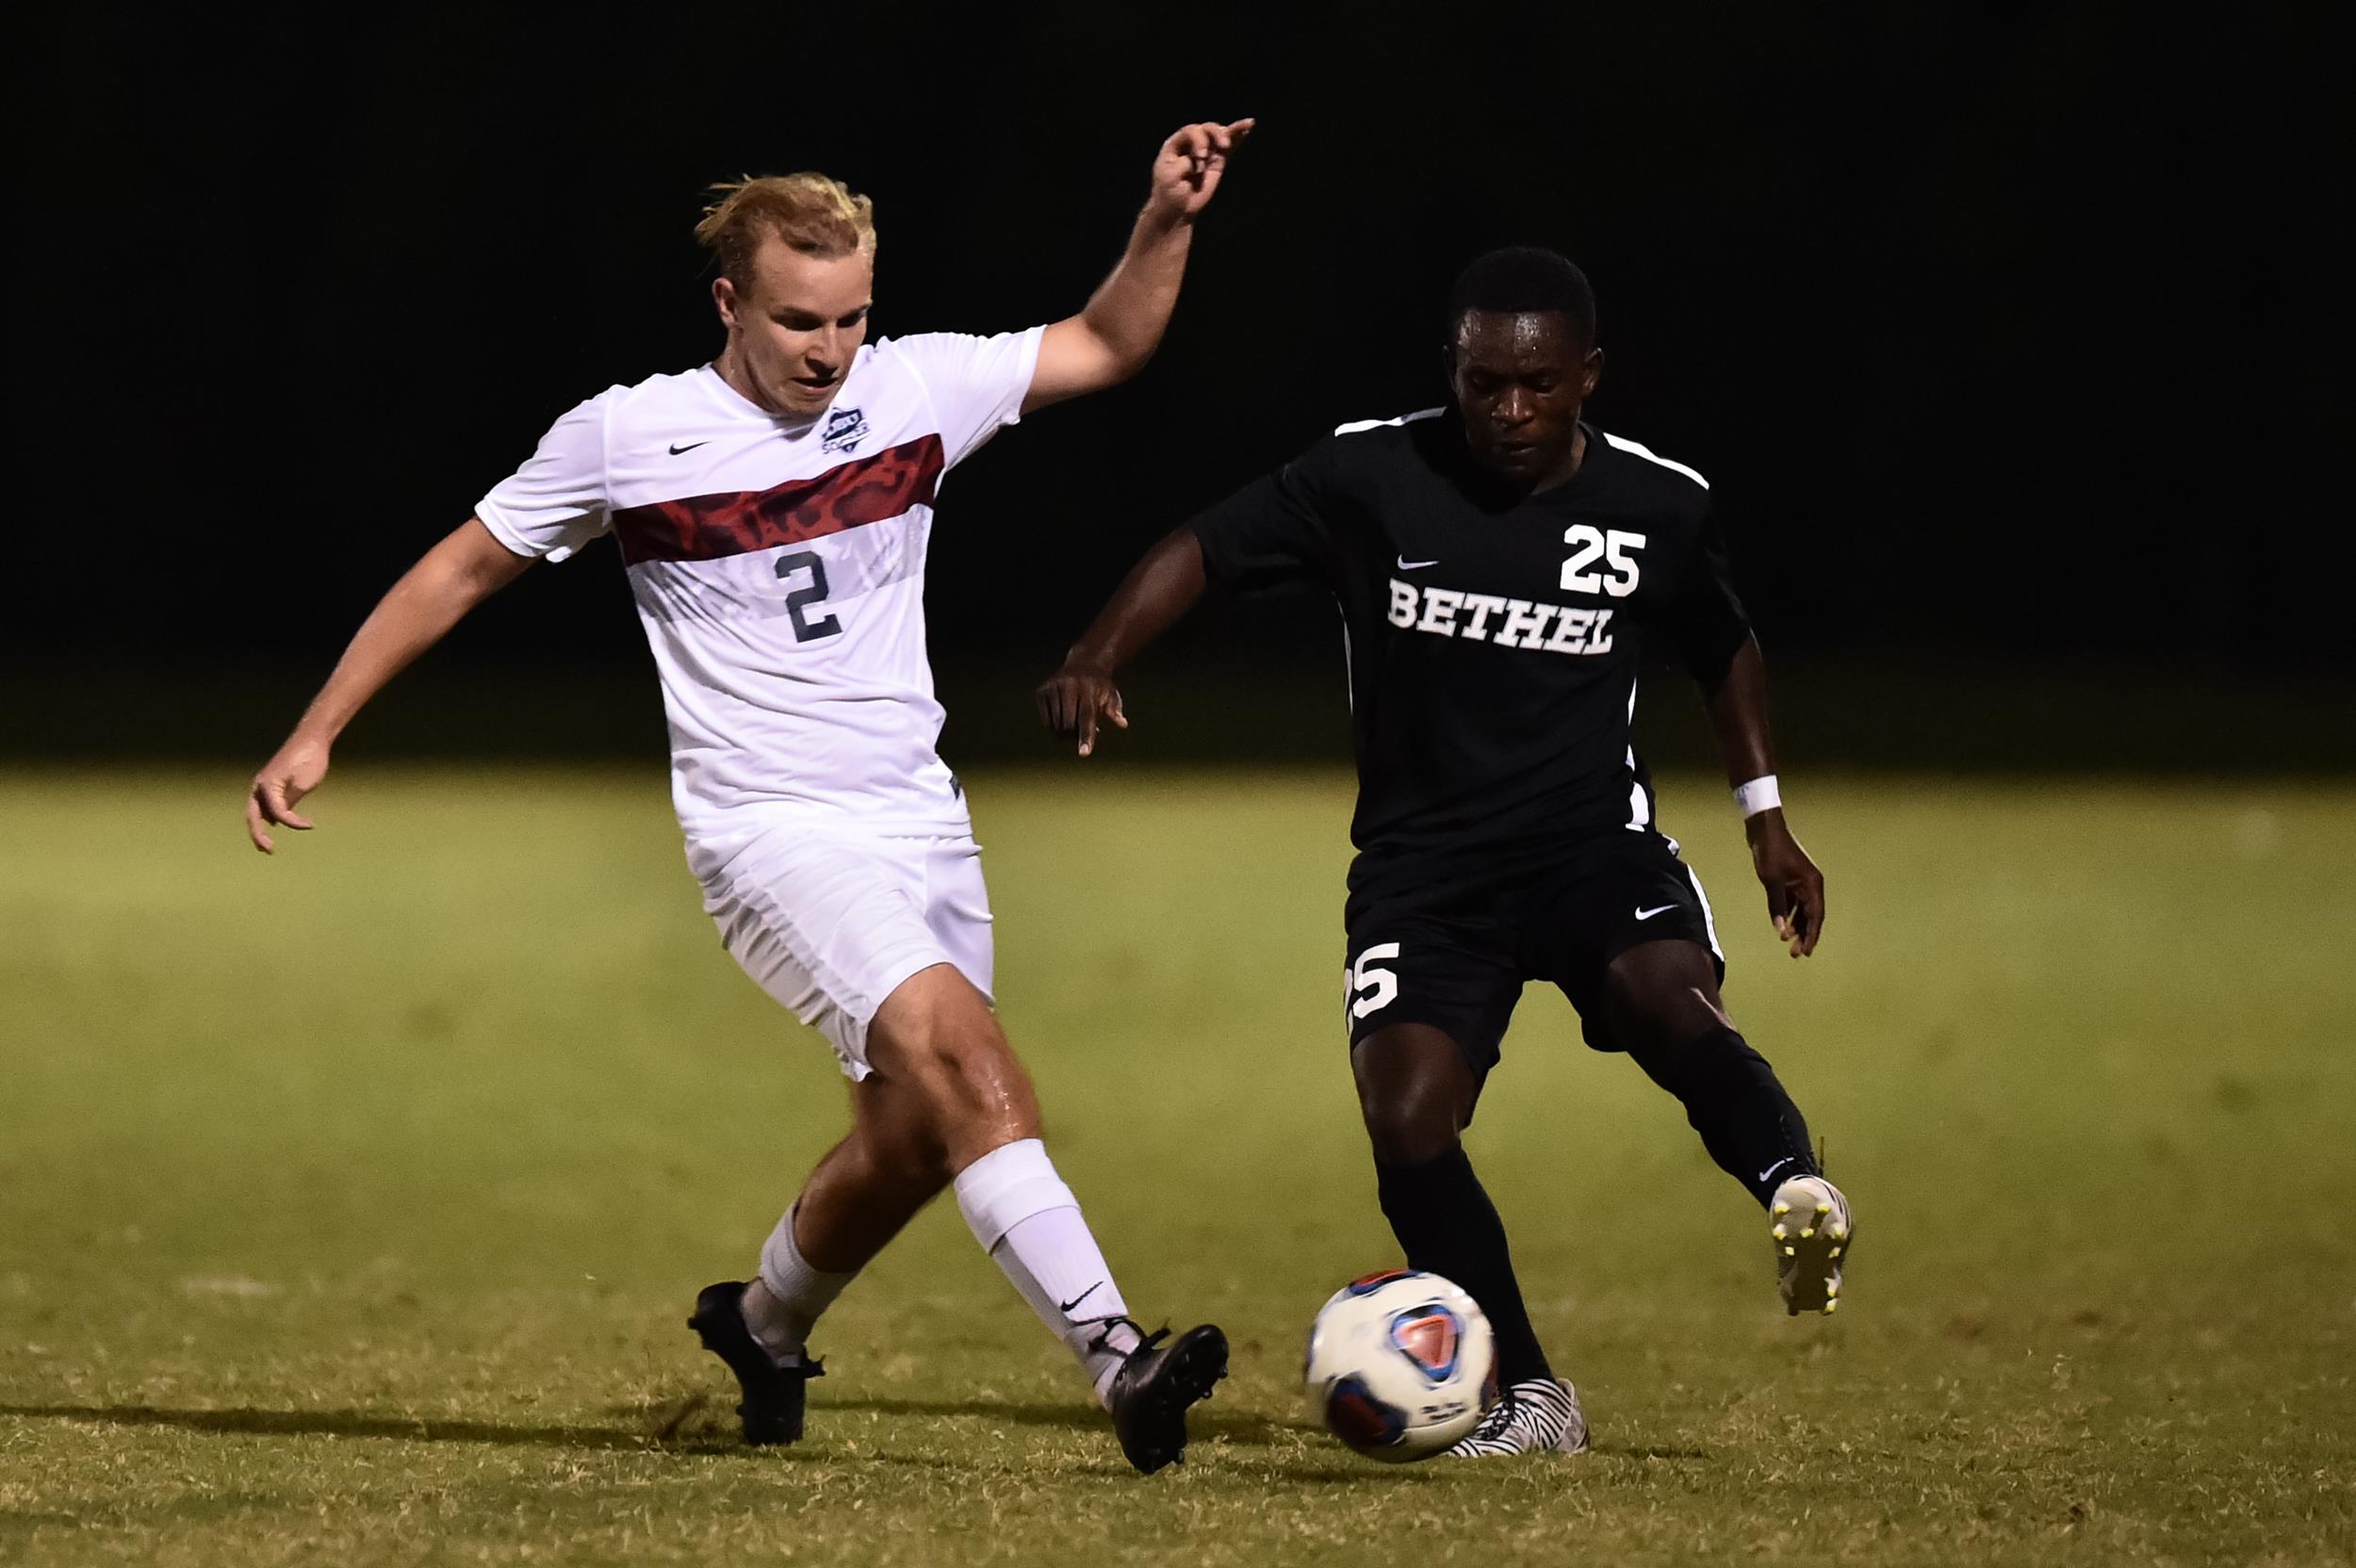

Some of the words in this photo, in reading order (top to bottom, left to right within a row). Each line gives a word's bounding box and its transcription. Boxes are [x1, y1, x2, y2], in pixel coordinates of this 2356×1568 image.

[774, 550, 843, 643] 2
[1560, 524, 1646, 597] 25
[1387, 577, 1613, 655] BETHEL
[1344, 942, 1400, 1036] 5
